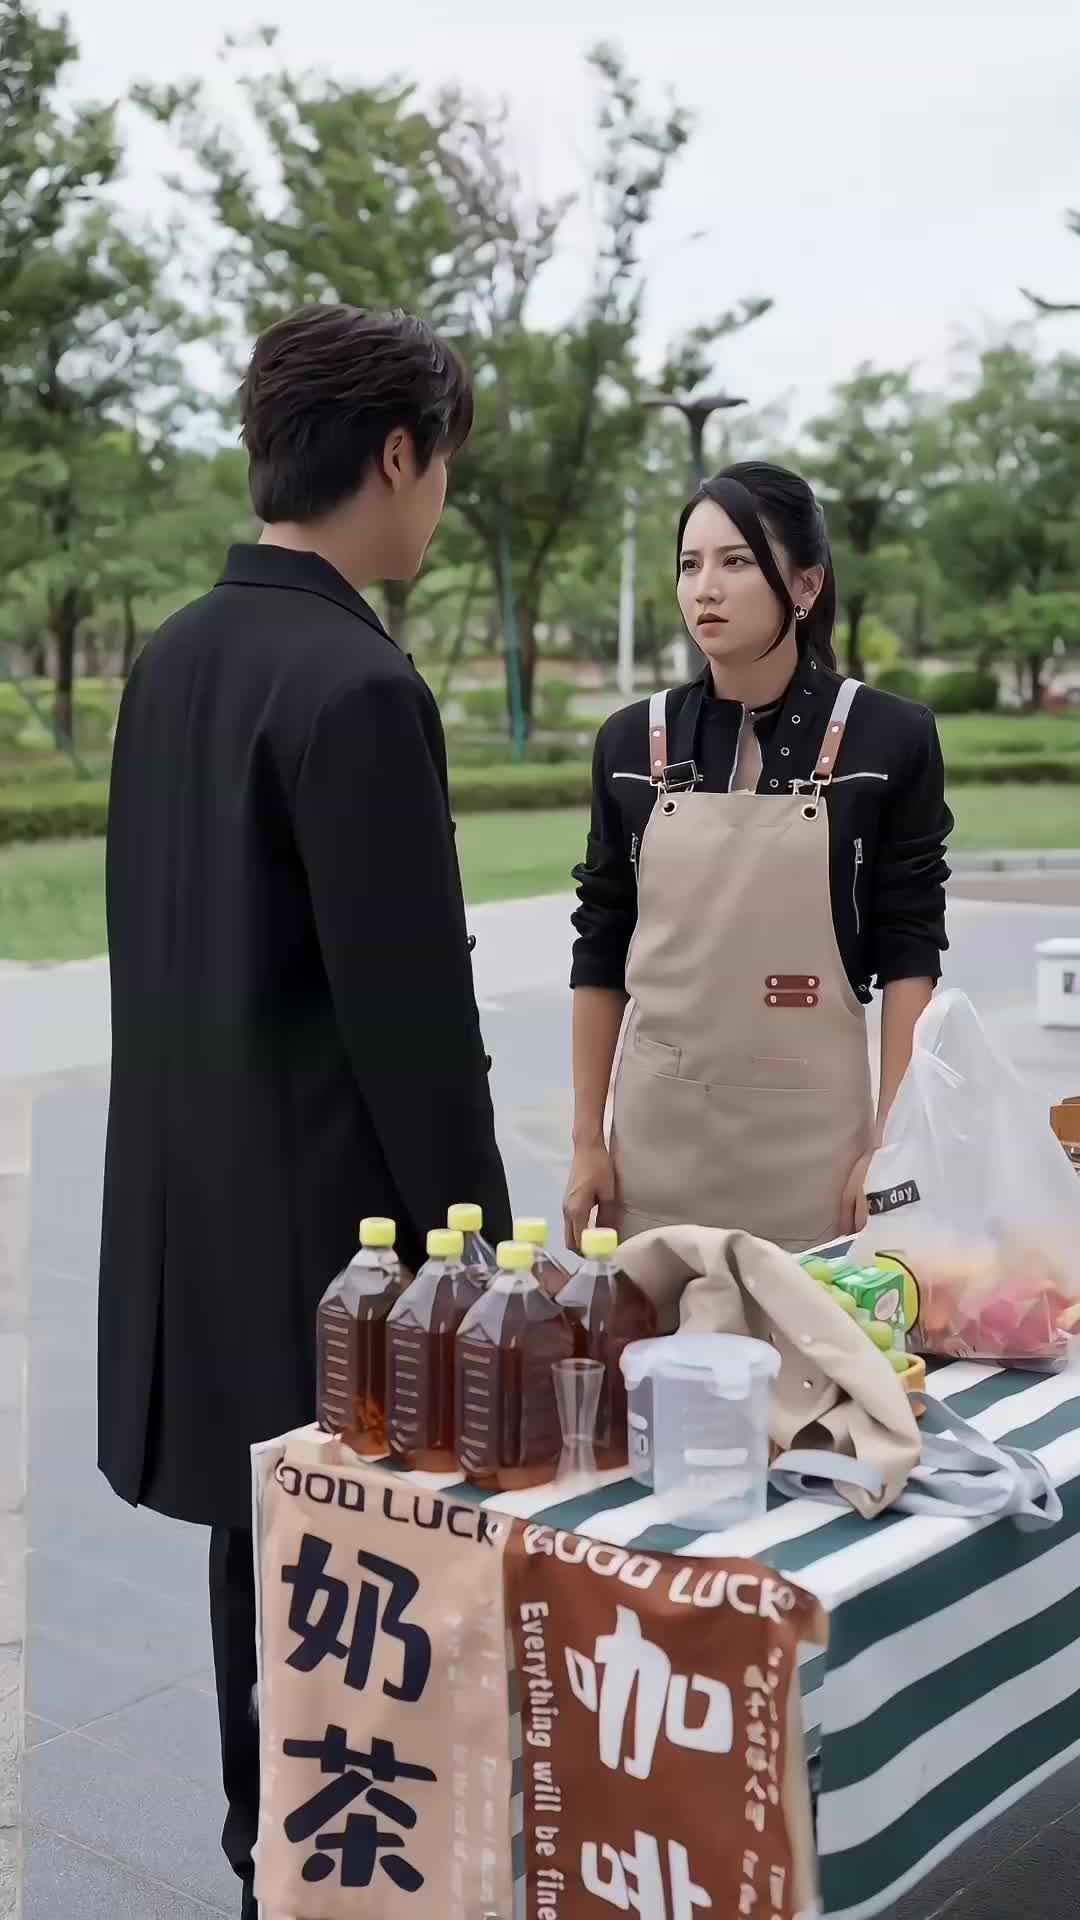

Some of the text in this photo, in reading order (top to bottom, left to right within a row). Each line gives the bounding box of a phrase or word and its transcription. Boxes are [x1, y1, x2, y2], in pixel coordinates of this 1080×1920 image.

[890, 1187, 912, 1204] day
[382, 1487, 495, 1547] LUCK
[522, 1523, 784, 1624] GOOD LUCK
[280, 1532, 438, 1893] 奶茶
[519, 1600, 565, 1920] Everything will be fine
